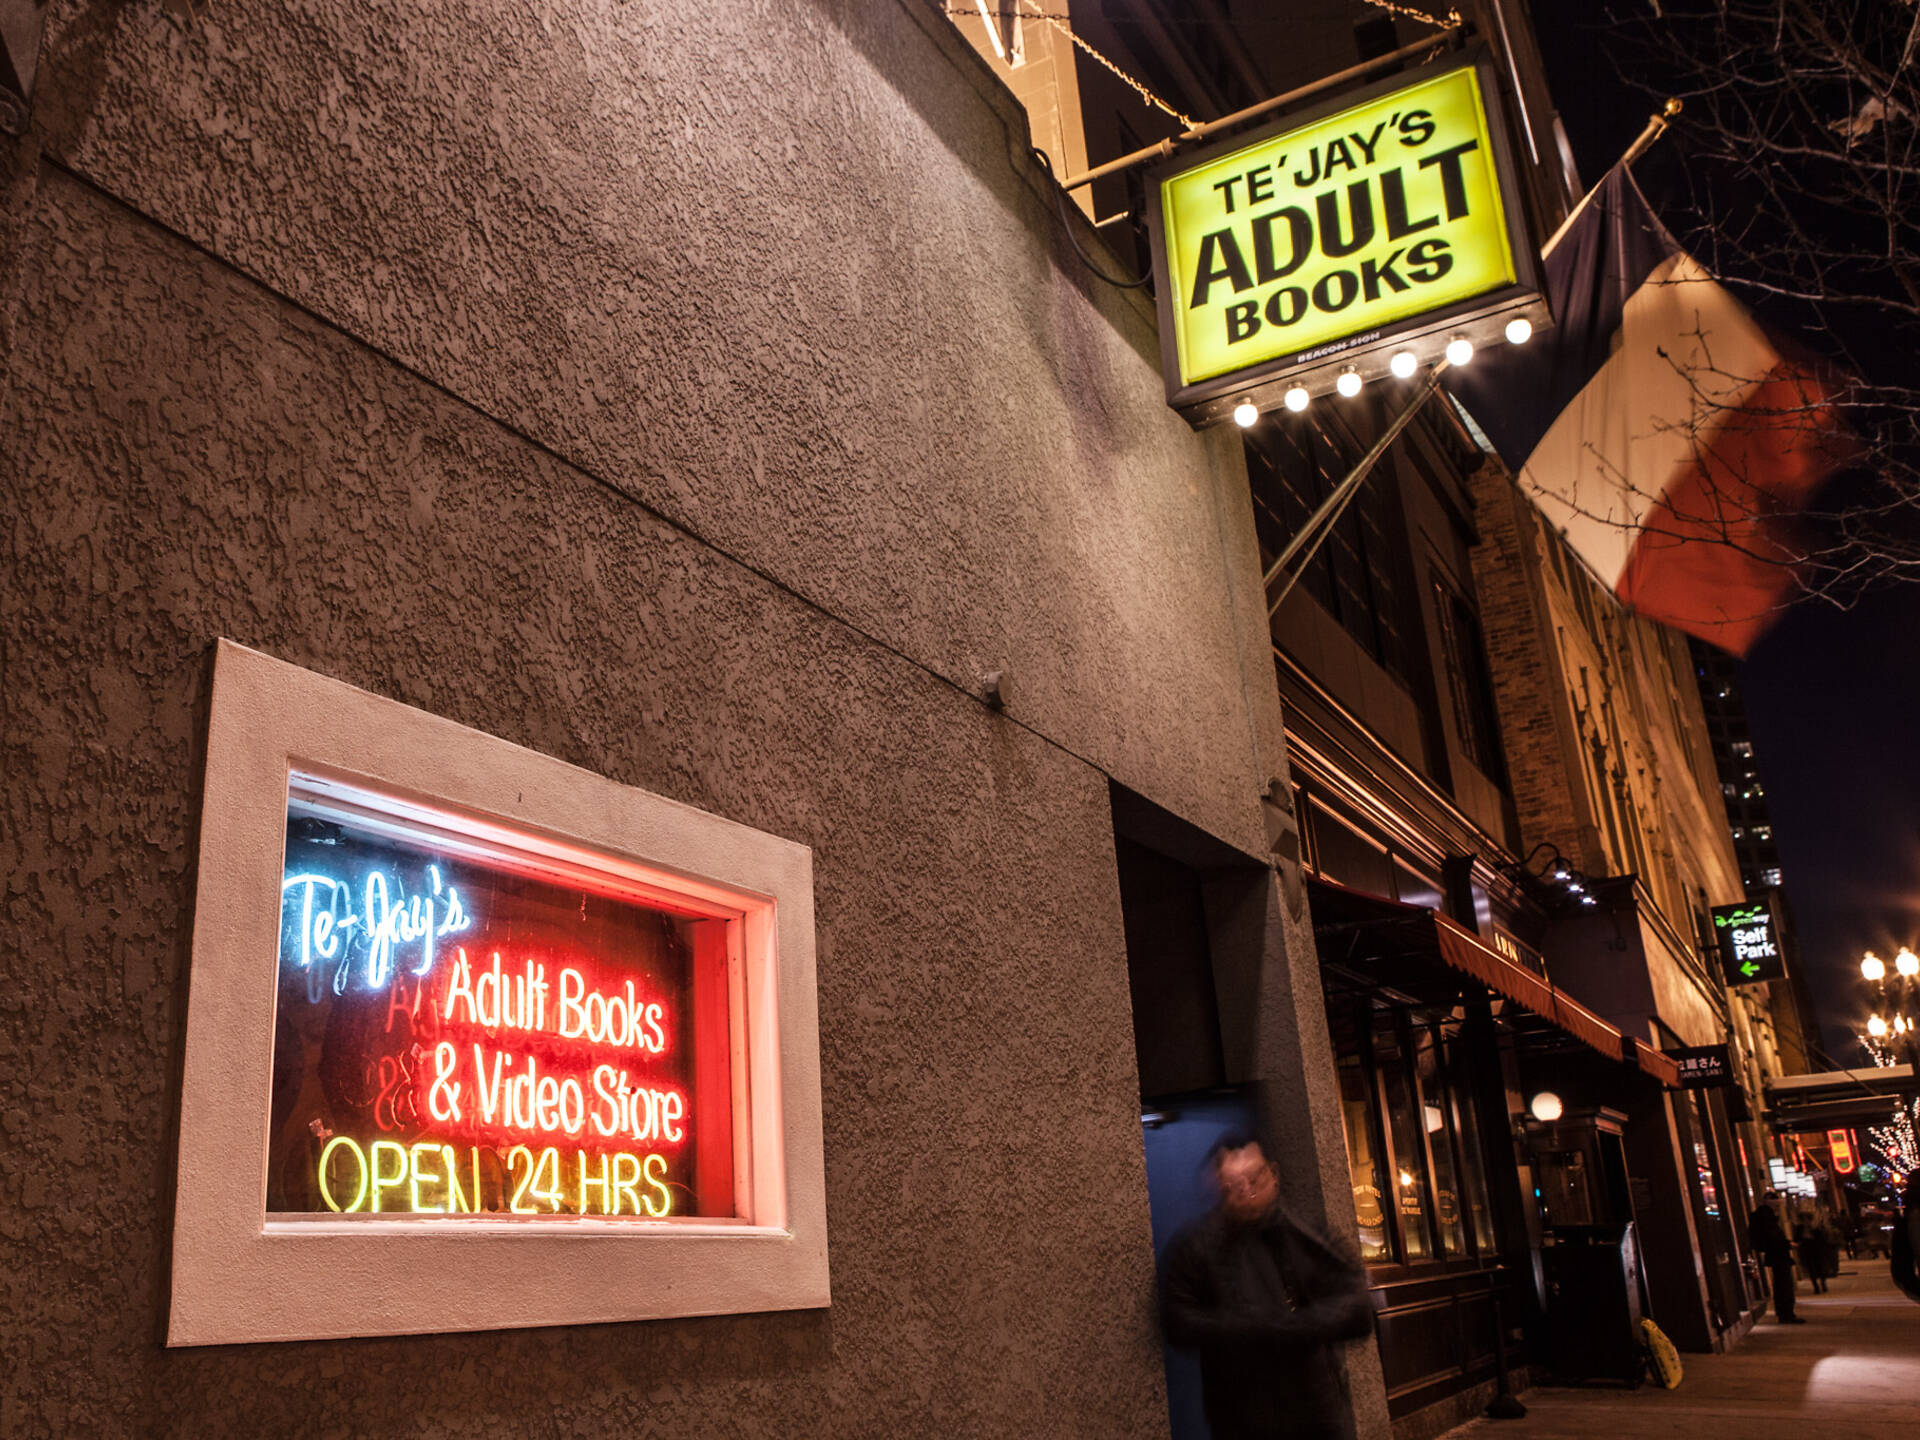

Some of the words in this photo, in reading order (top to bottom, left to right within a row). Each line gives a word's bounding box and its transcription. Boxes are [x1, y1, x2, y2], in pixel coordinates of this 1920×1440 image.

[1189, 138, 1479, 310] ADULT
[1224, 238, 1454, 346] BOOKS
[1297, 342, 1346, 363] BEACON
[1349, 331, 1381, 347] SIGN
[282, 864, 472, 989] Te-Jay's
[1732, 926, 1769, 945] Self
[1735, 942, 1777, 960] Park
[444, 948, 549, 1031] Adult
[559, 968, 665, 1053] Books
[429, 1042, 462, 1121] &
[474, 1043, 584, 1134] Video
[591, 1065, 684, 1142] Store
[318, 1136, 481, 1214] OPEN
[508, 1146, 564, 1215] 24
[579, 1149, 671, 1217] HRS
